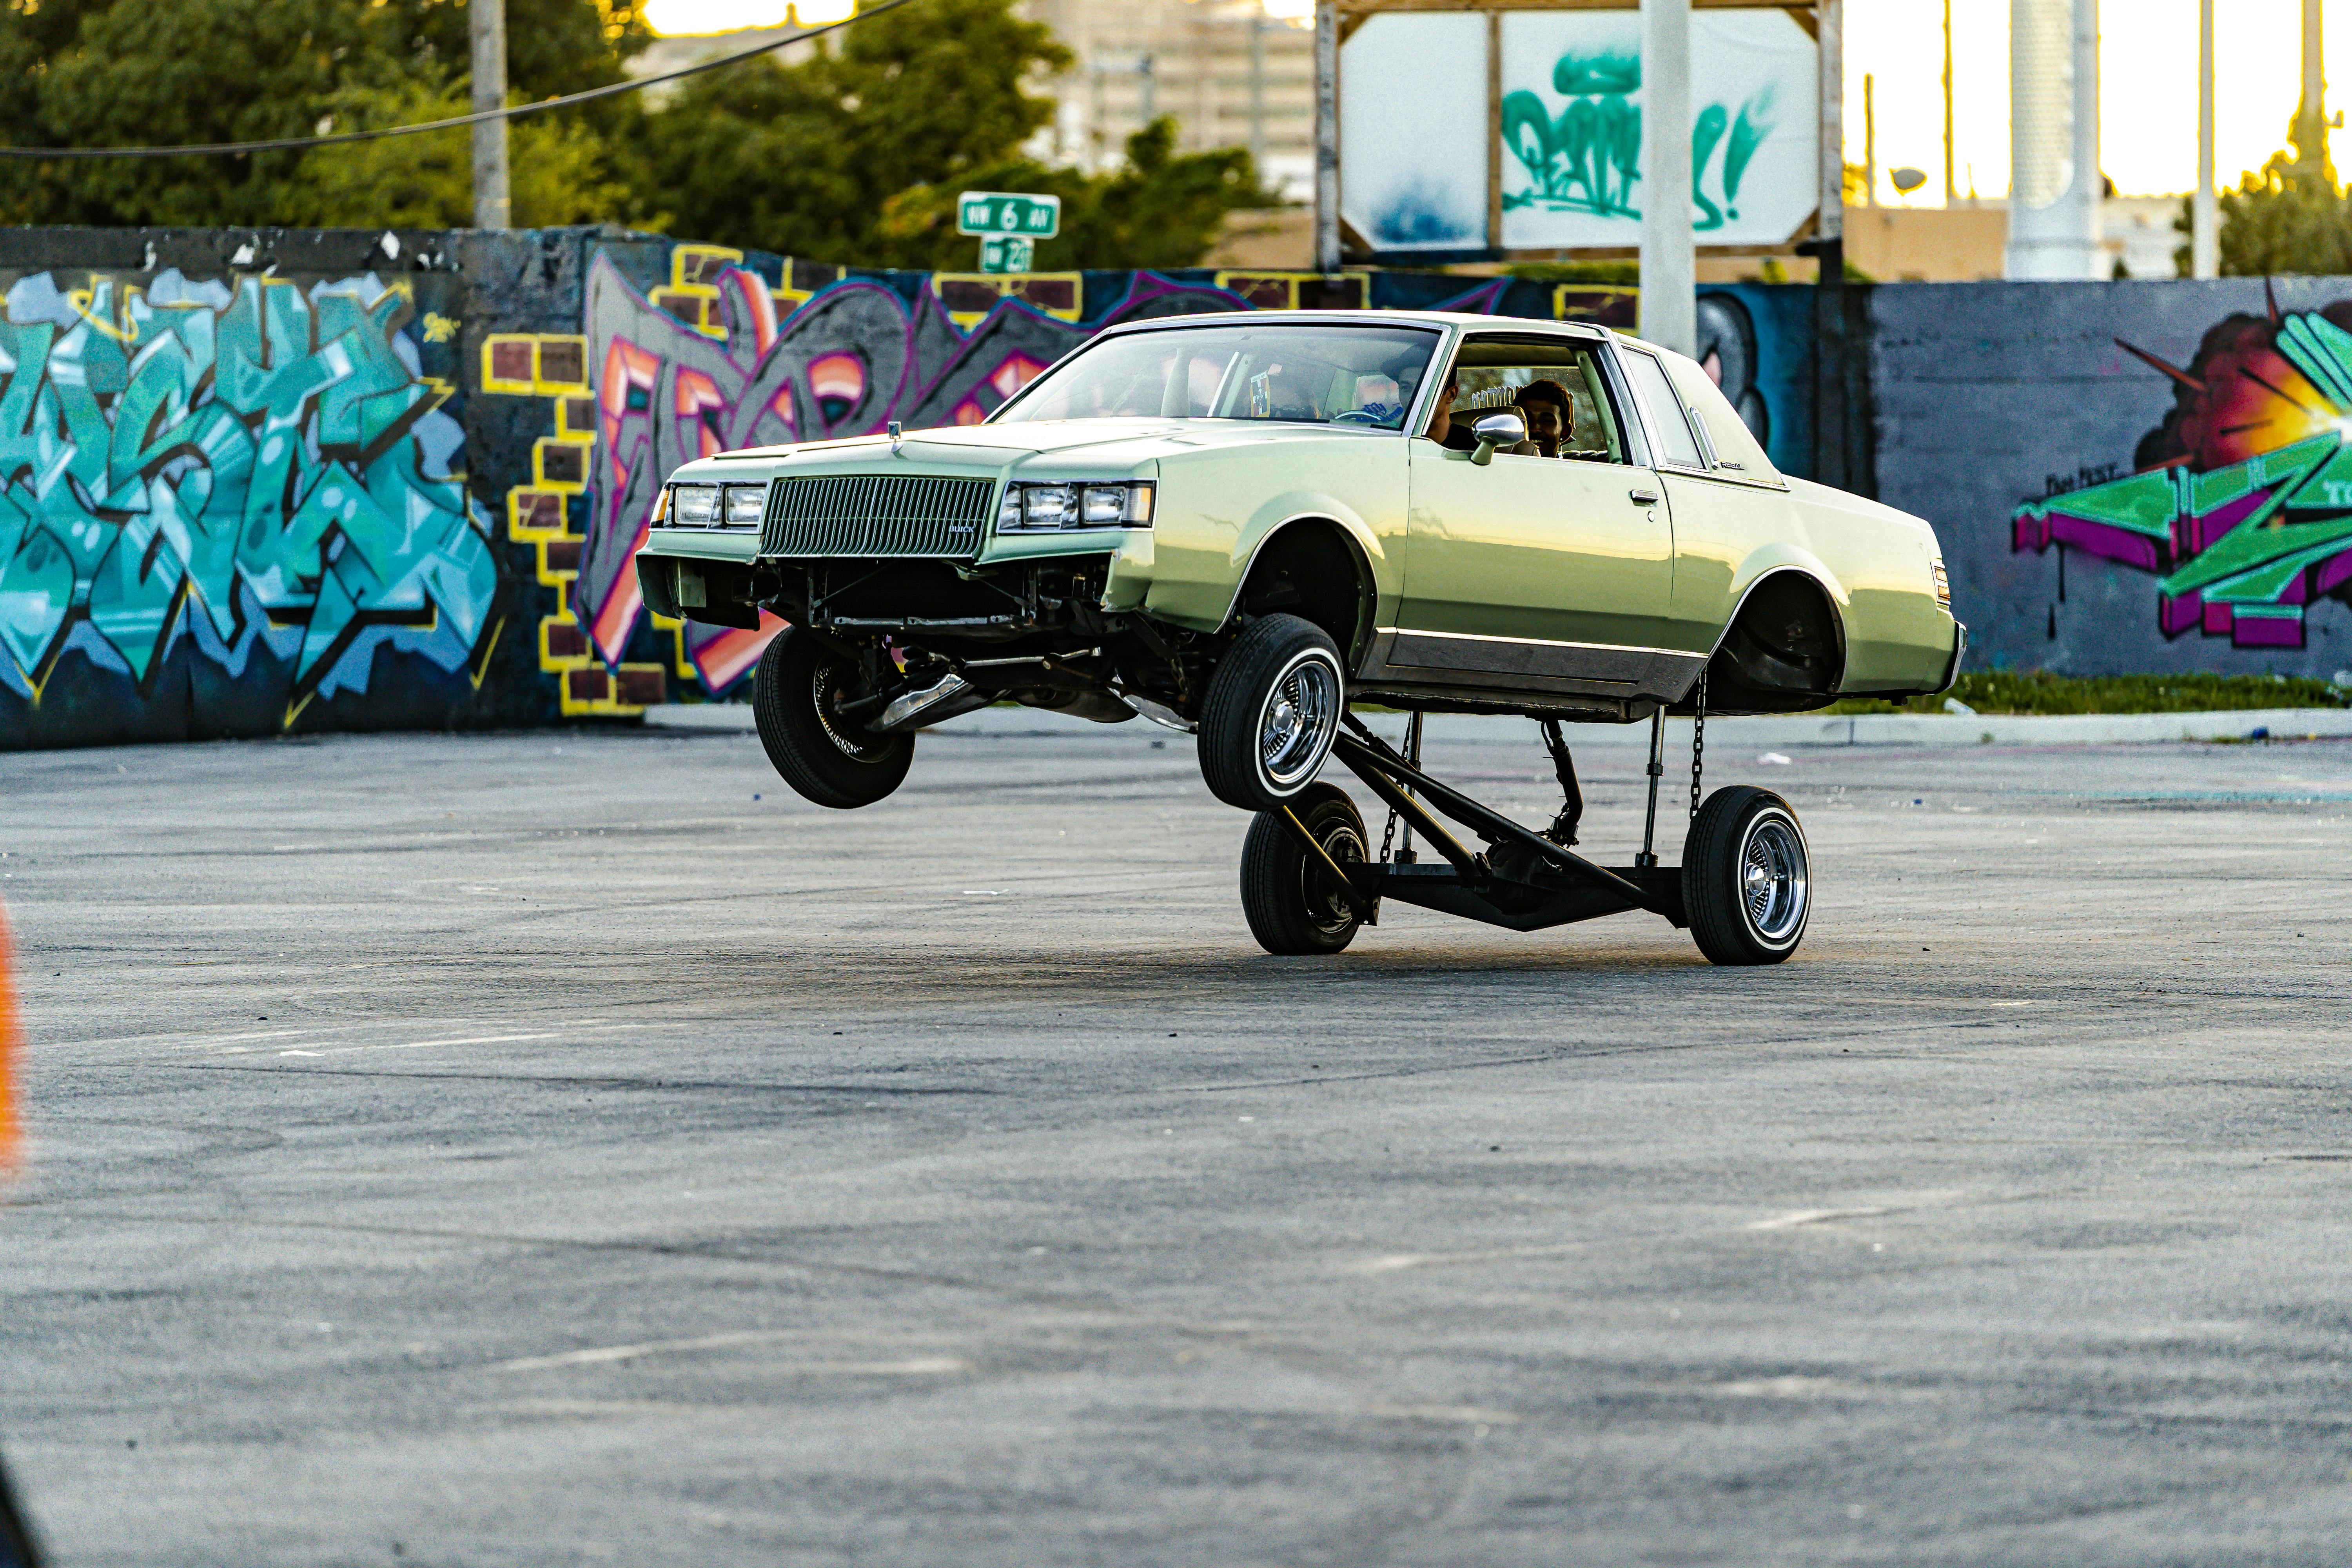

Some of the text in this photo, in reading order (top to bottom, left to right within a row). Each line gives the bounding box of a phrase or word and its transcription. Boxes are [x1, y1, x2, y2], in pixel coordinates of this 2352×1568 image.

[966, 201, 1050, 230] NW 6 AV
[1720, 462, 1744, 470] REGAL
